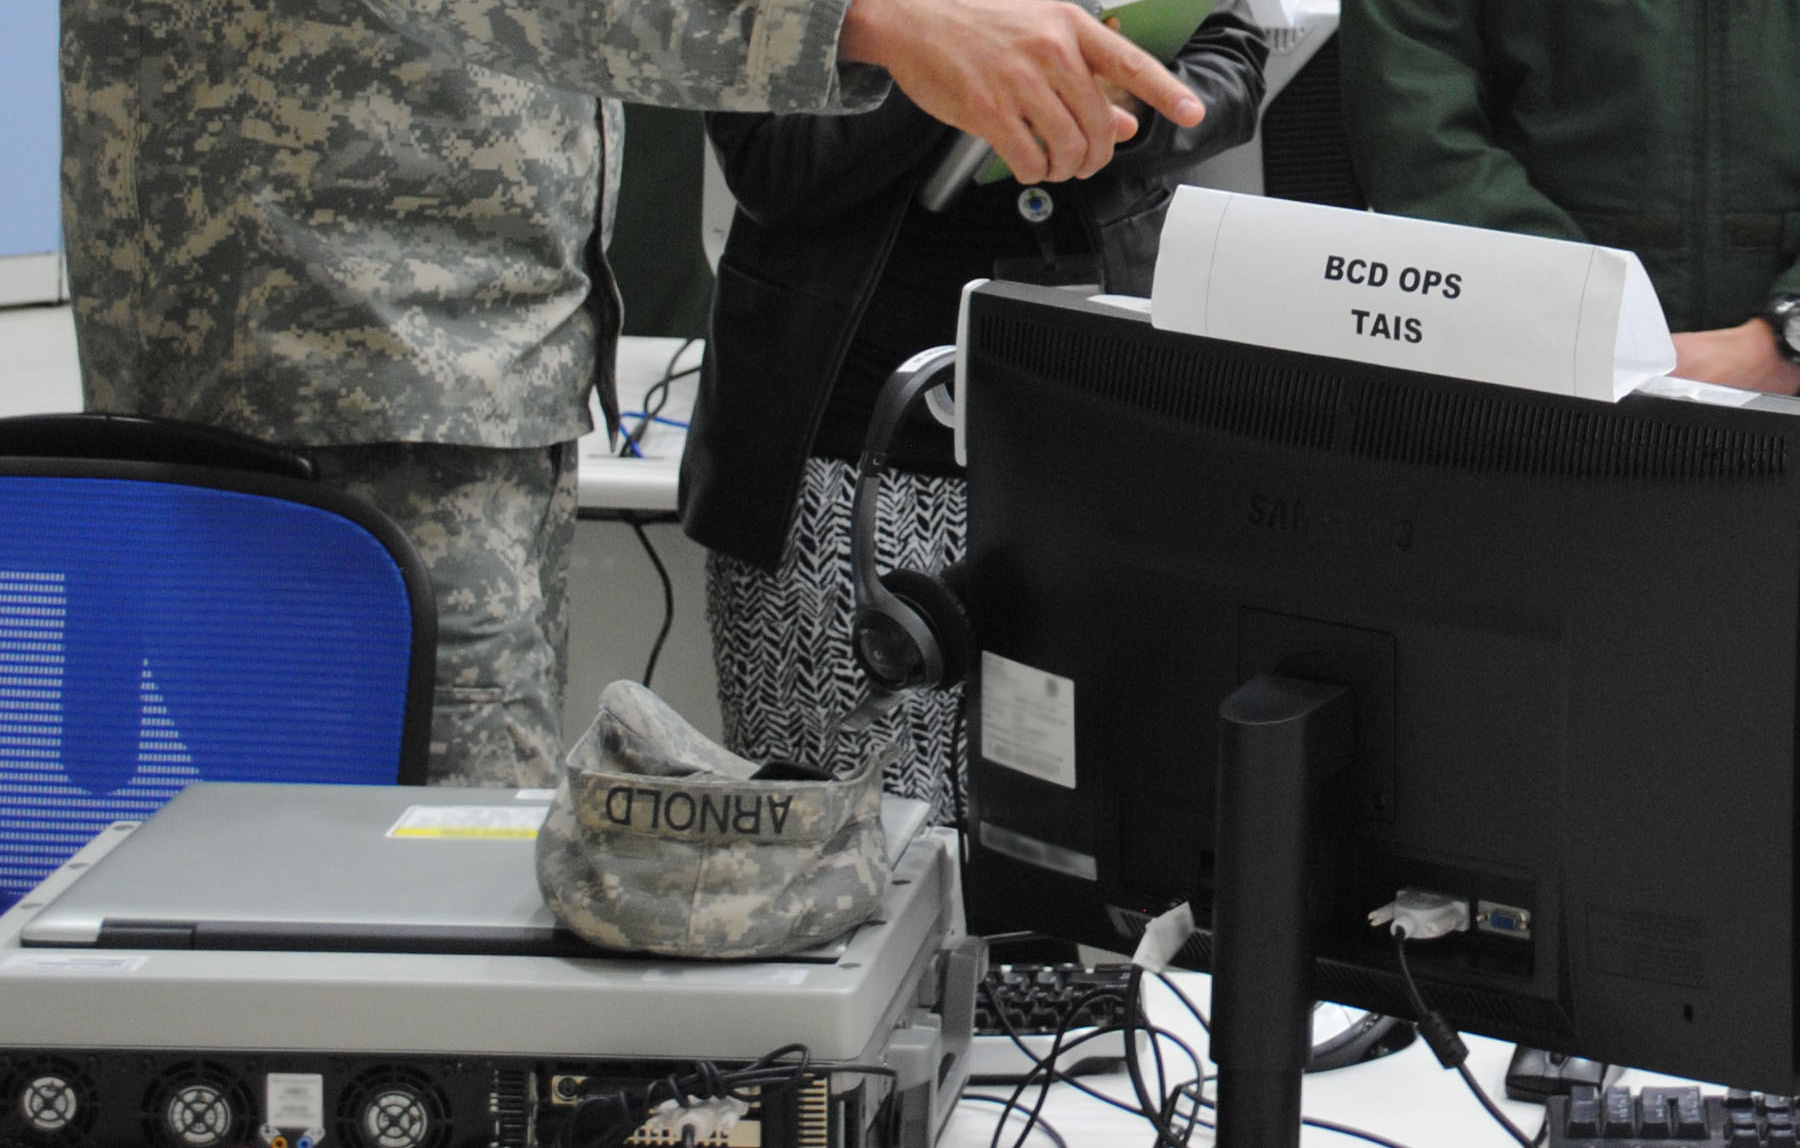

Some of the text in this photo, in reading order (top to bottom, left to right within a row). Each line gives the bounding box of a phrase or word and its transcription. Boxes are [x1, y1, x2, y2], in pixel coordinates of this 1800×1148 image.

[1323, 254, 1463, 300] BCD OPS
[1350, 308, 1423, 344] TAIS
[604, 785, 794, 835] ARNOLD
